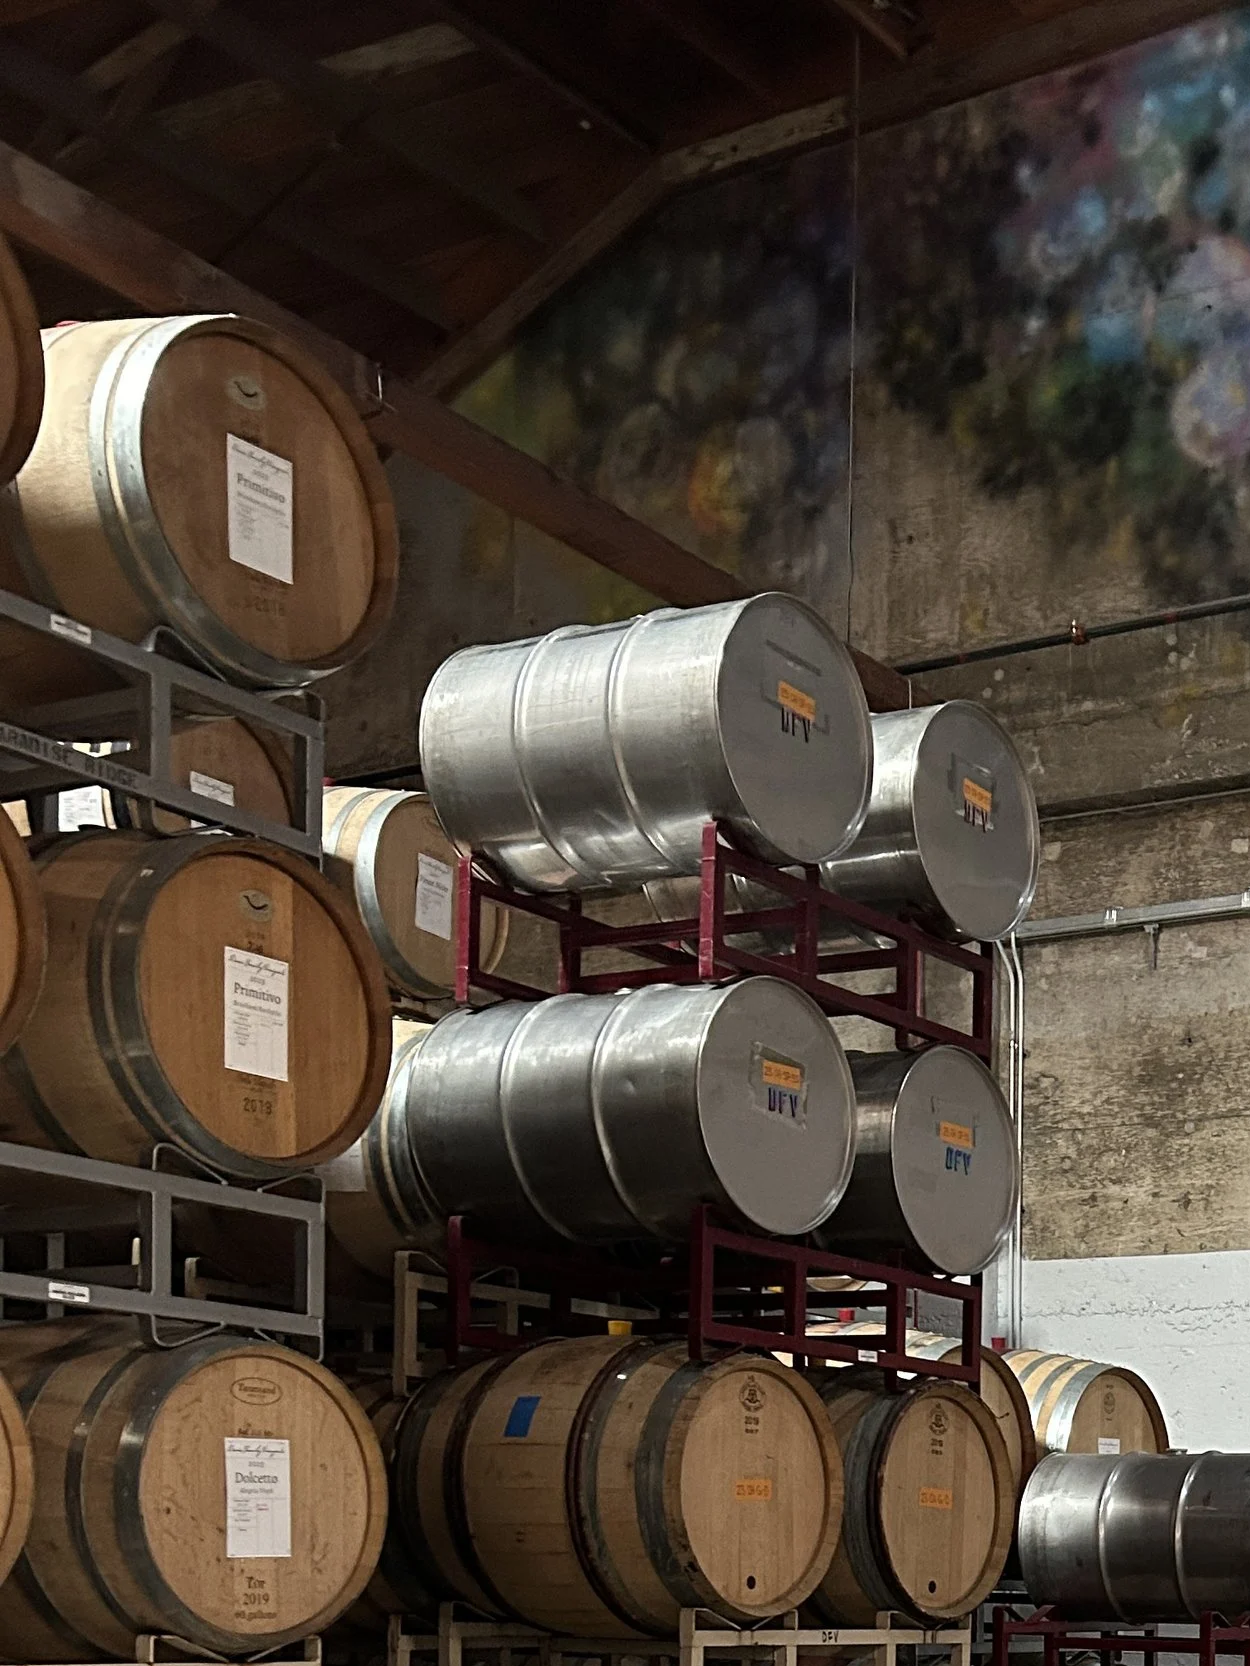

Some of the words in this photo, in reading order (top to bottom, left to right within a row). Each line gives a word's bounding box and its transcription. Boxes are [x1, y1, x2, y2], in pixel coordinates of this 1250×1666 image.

[237, 473, 286, 503] Primitivo
[233, 981, 282, 1005] Primitivo
[945, 1146, 972, 1176] DFV
[235, 1471, 279, 1484] Dolcetto
[242, 1592, 270, 1606] 2019
